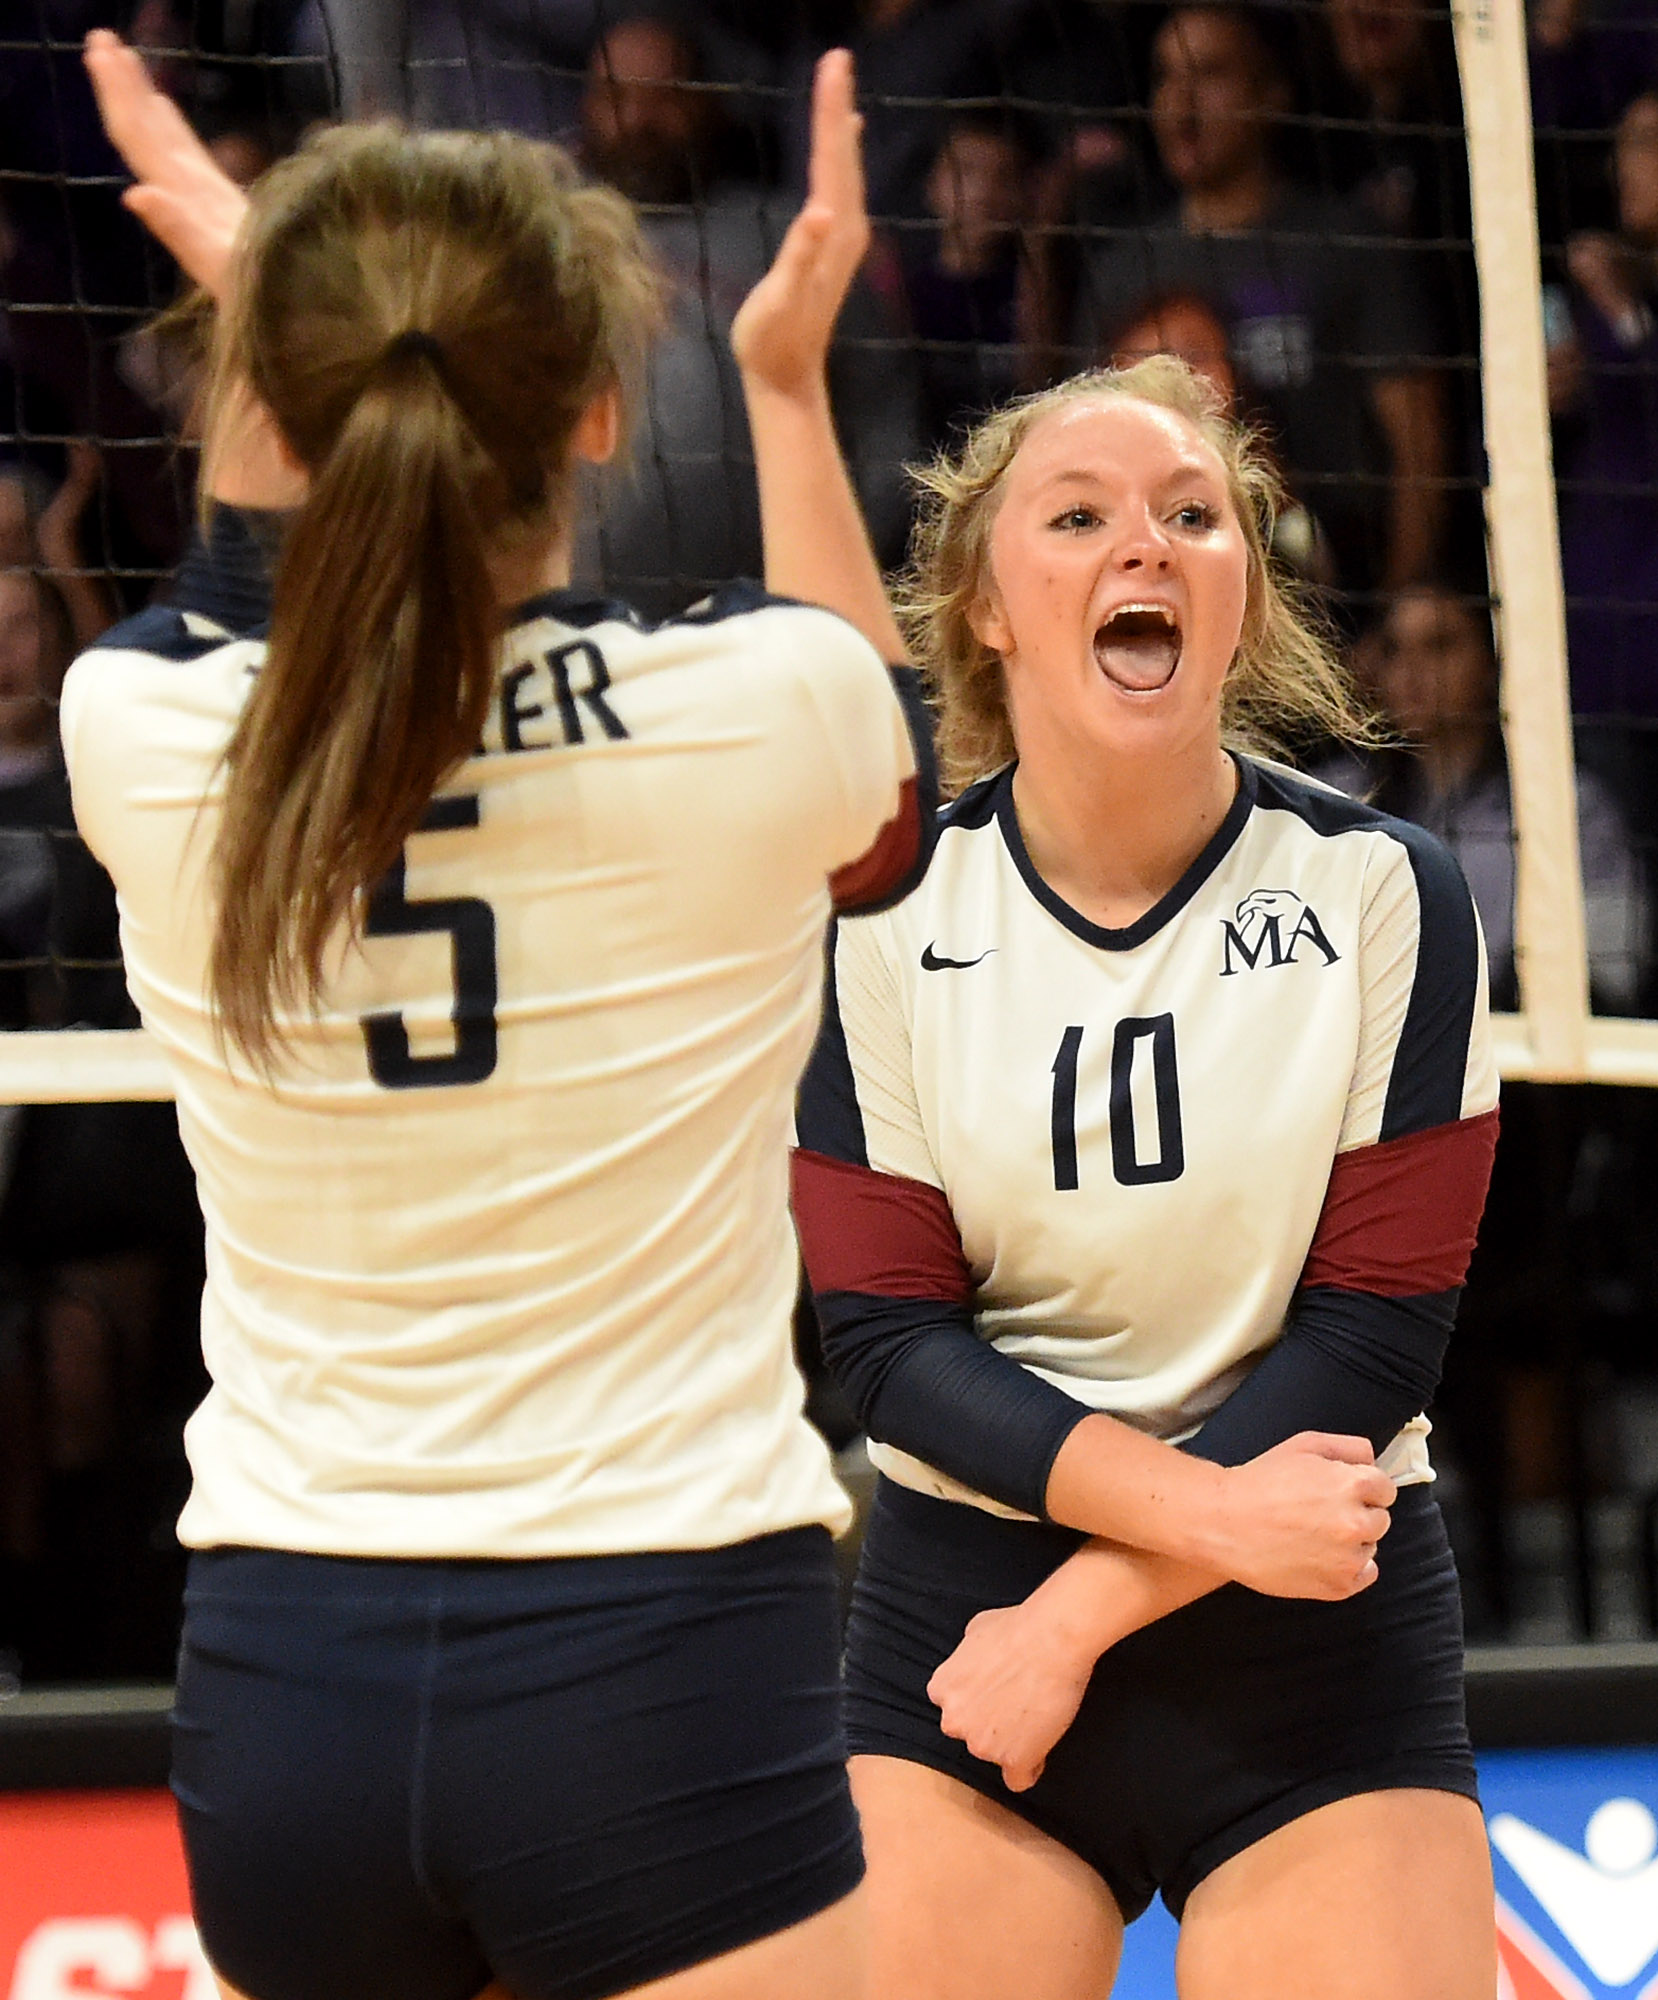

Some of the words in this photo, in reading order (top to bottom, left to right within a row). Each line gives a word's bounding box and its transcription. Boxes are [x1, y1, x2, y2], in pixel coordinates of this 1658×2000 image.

[472, 638, 630, 756] ER
[359, 794, 499, 1091] 5
[1218, 905, 1342, 977] MA
[1050, 1011, 1185, 1191] 10
